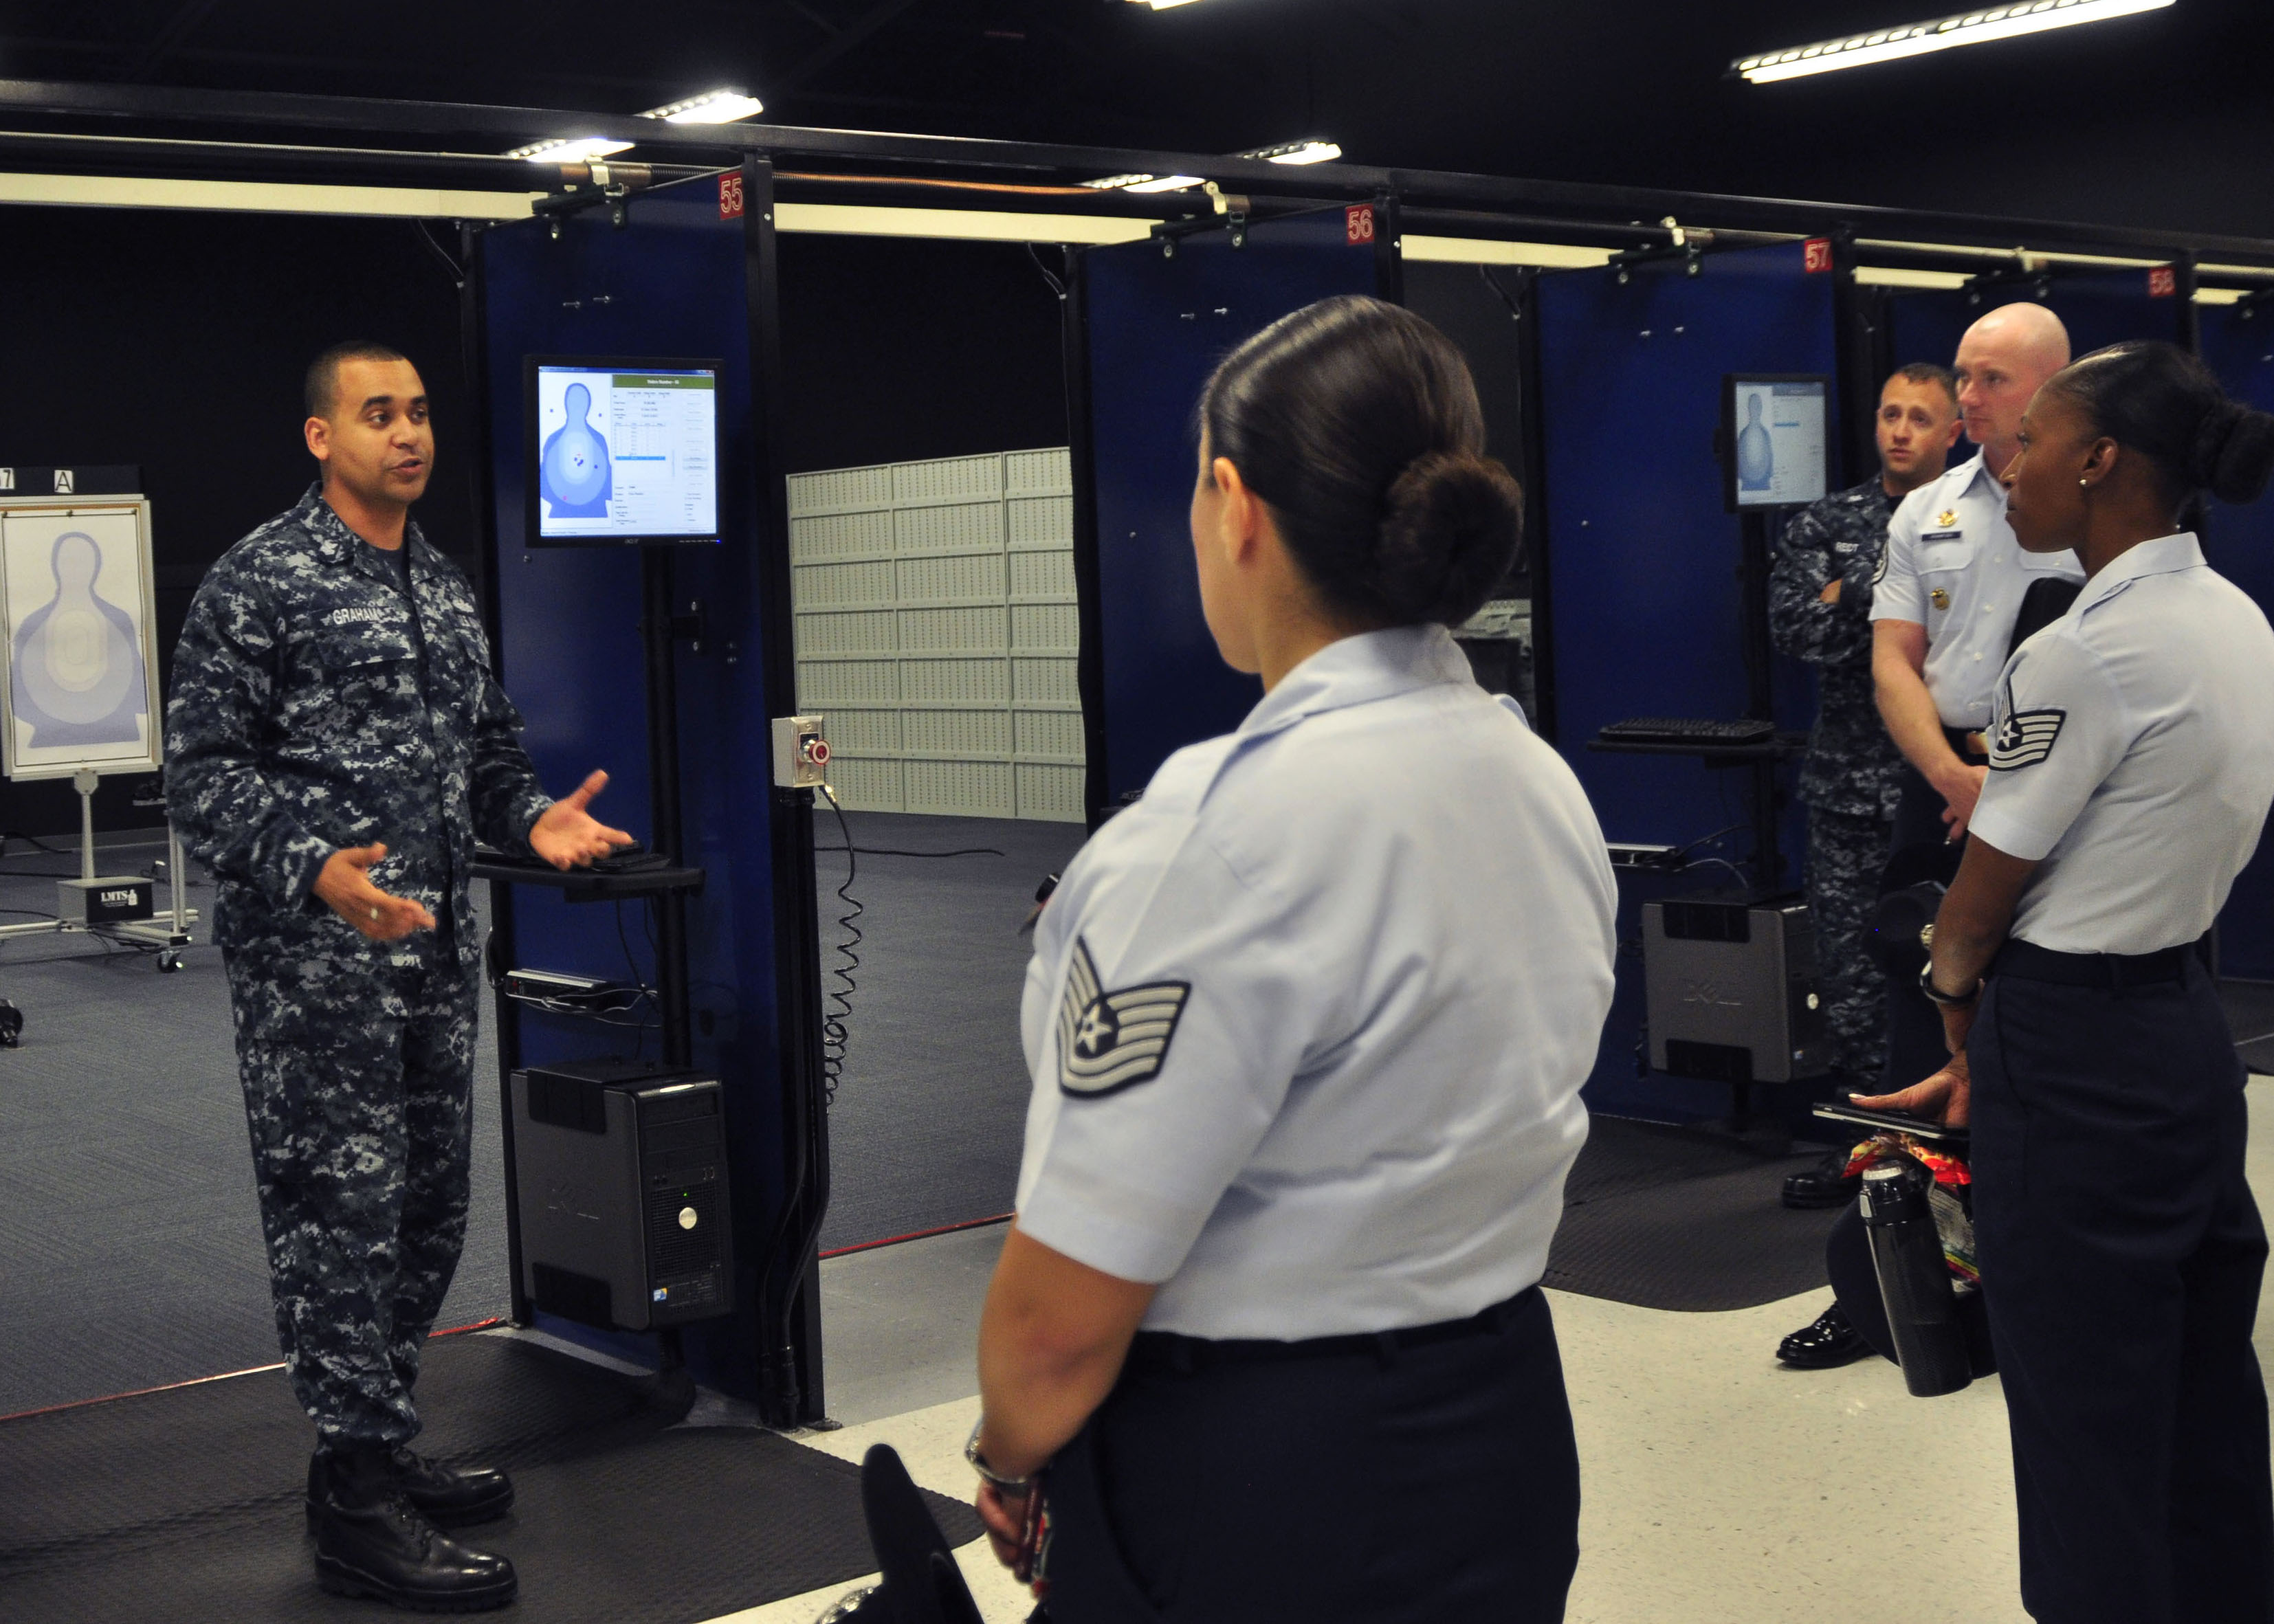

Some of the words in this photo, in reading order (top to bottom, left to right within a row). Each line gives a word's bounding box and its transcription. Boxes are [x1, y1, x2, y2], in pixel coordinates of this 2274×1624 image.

[720, 177, 743, 213] 55
[1349, 209, 1373, 240] 56
[1807, 242, 1831, 269] 57
[0, 469, 11, 488] 7
[55, 471, 71, 491] A
[333, 608, 380, 625] GRAHAM
